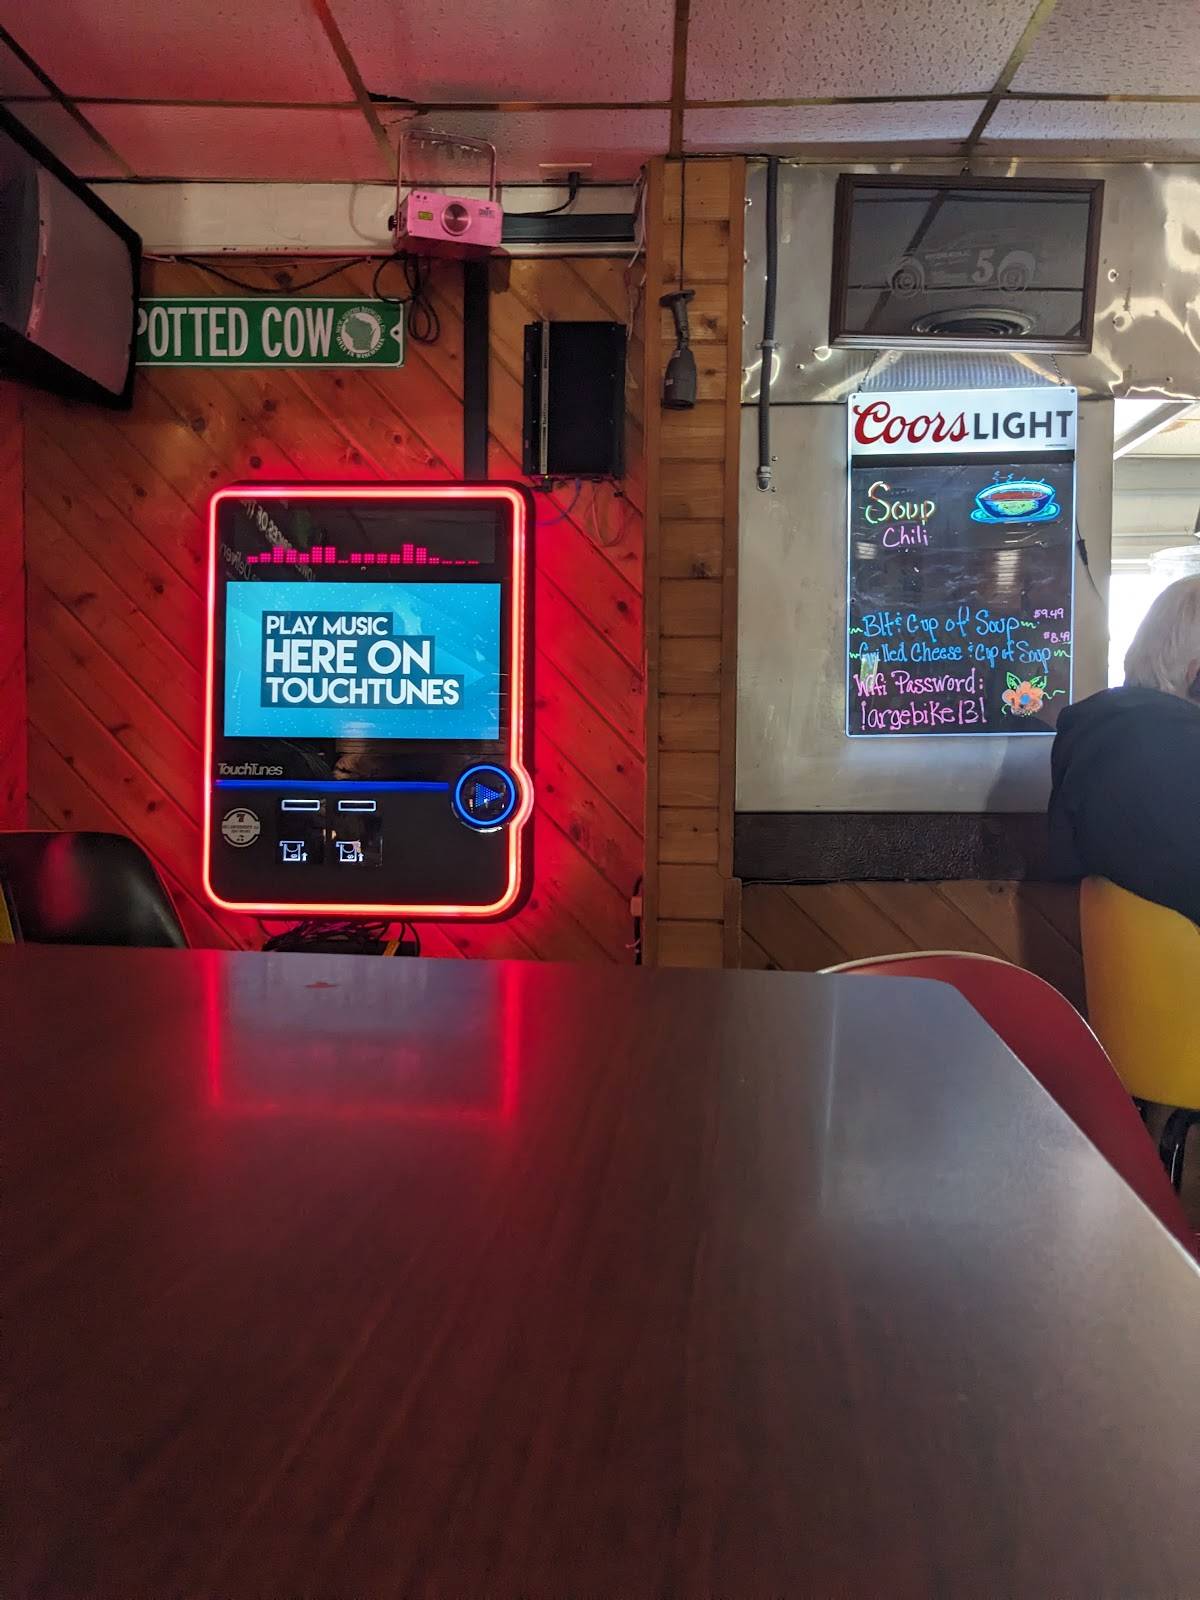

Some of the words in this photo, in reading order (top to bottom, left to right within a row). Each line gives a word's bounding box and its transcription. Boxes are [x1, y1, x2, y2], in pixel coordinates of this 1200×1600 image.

[971, 248, 995, 283] 5
[262, 306, 335, 358] COW
[852, 401, 970, 445] Coors
[973, 410, 1074, 440] LIGHT
[865, 480, 937, 526] Soup
[882, 525, 930, 548] Chili
[266, 615, 318, 635] PLAY
[323, 616, 389, 636] MUSIC
[907, 614, 939, 643] Cup
[945, 606, 970, 637] of
[976, 609, 1020, 643] Soup
[1033, 608, 1064, 619] $9.49
[1043, 631, 1071, 643] $8.49
[265, 638, 358, 675] HERE
[367, 639, 431, 675] ON
[911, 642, 963, 662] Cheese
[974, 643, 999, 668] Cup
[1017, 641, 1052, 673] Soup
[265, 676, 460, 706] TOUCHTUNES
[890, 667, 984, 694] Password:
[218, 762, 284, 776] TouchTunes
